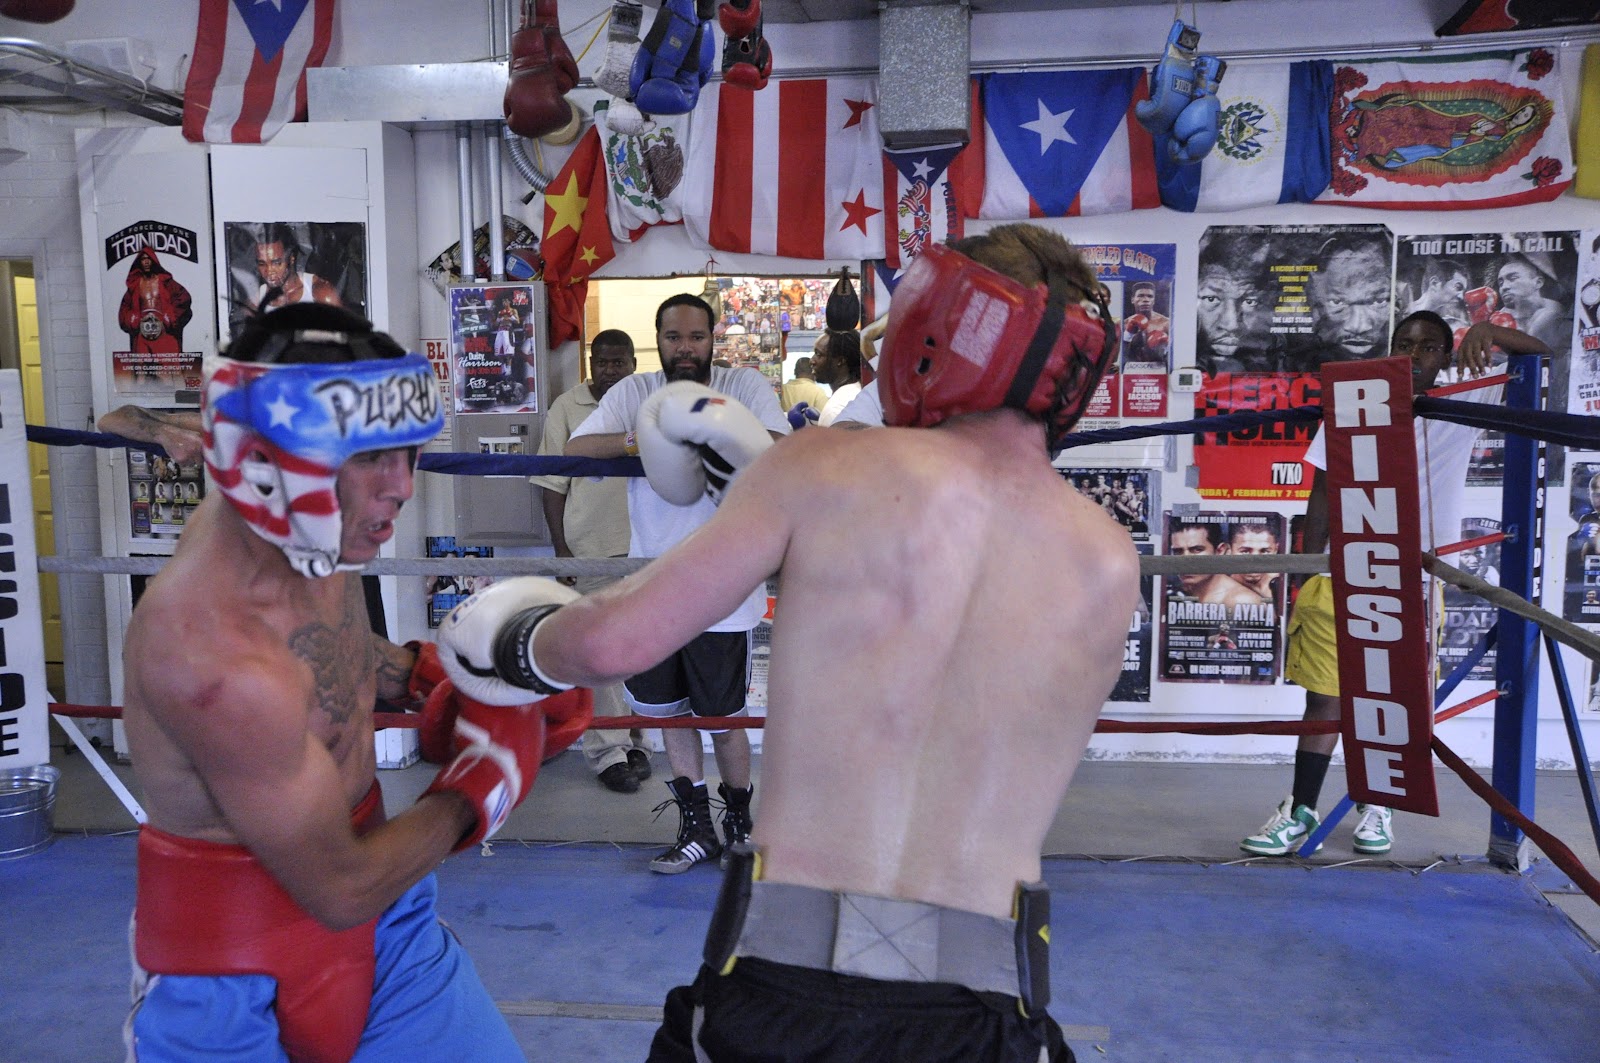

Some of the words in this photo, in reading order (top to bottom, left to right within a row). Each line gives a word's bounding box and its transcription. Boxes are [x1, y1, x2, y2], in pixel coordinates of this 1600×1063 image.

[111, 231, 192, 261] TRINIDAD
[1411, 240, 1442, 256] TOO
[1445, 239, 1495, 255] CLOSE
[1524, 237, 1564, 253] CALL
[458, 356, 502, 368] Harrison
[1127, 393, 1162, 401] JACKSON
[1271, 462, 1303, 485] TVKO
[1233, 489, 1283, 497] FEBRUARY
[1333, 379, 1410, 796] RINGSIDE
[1168, 601, 1226, 624] BARRERA
[1233, 603, 1275, 626] AYALA
[1238, 640, 1273, 648] TAYLOR
[1251, 652, 1274, 662] HBO
